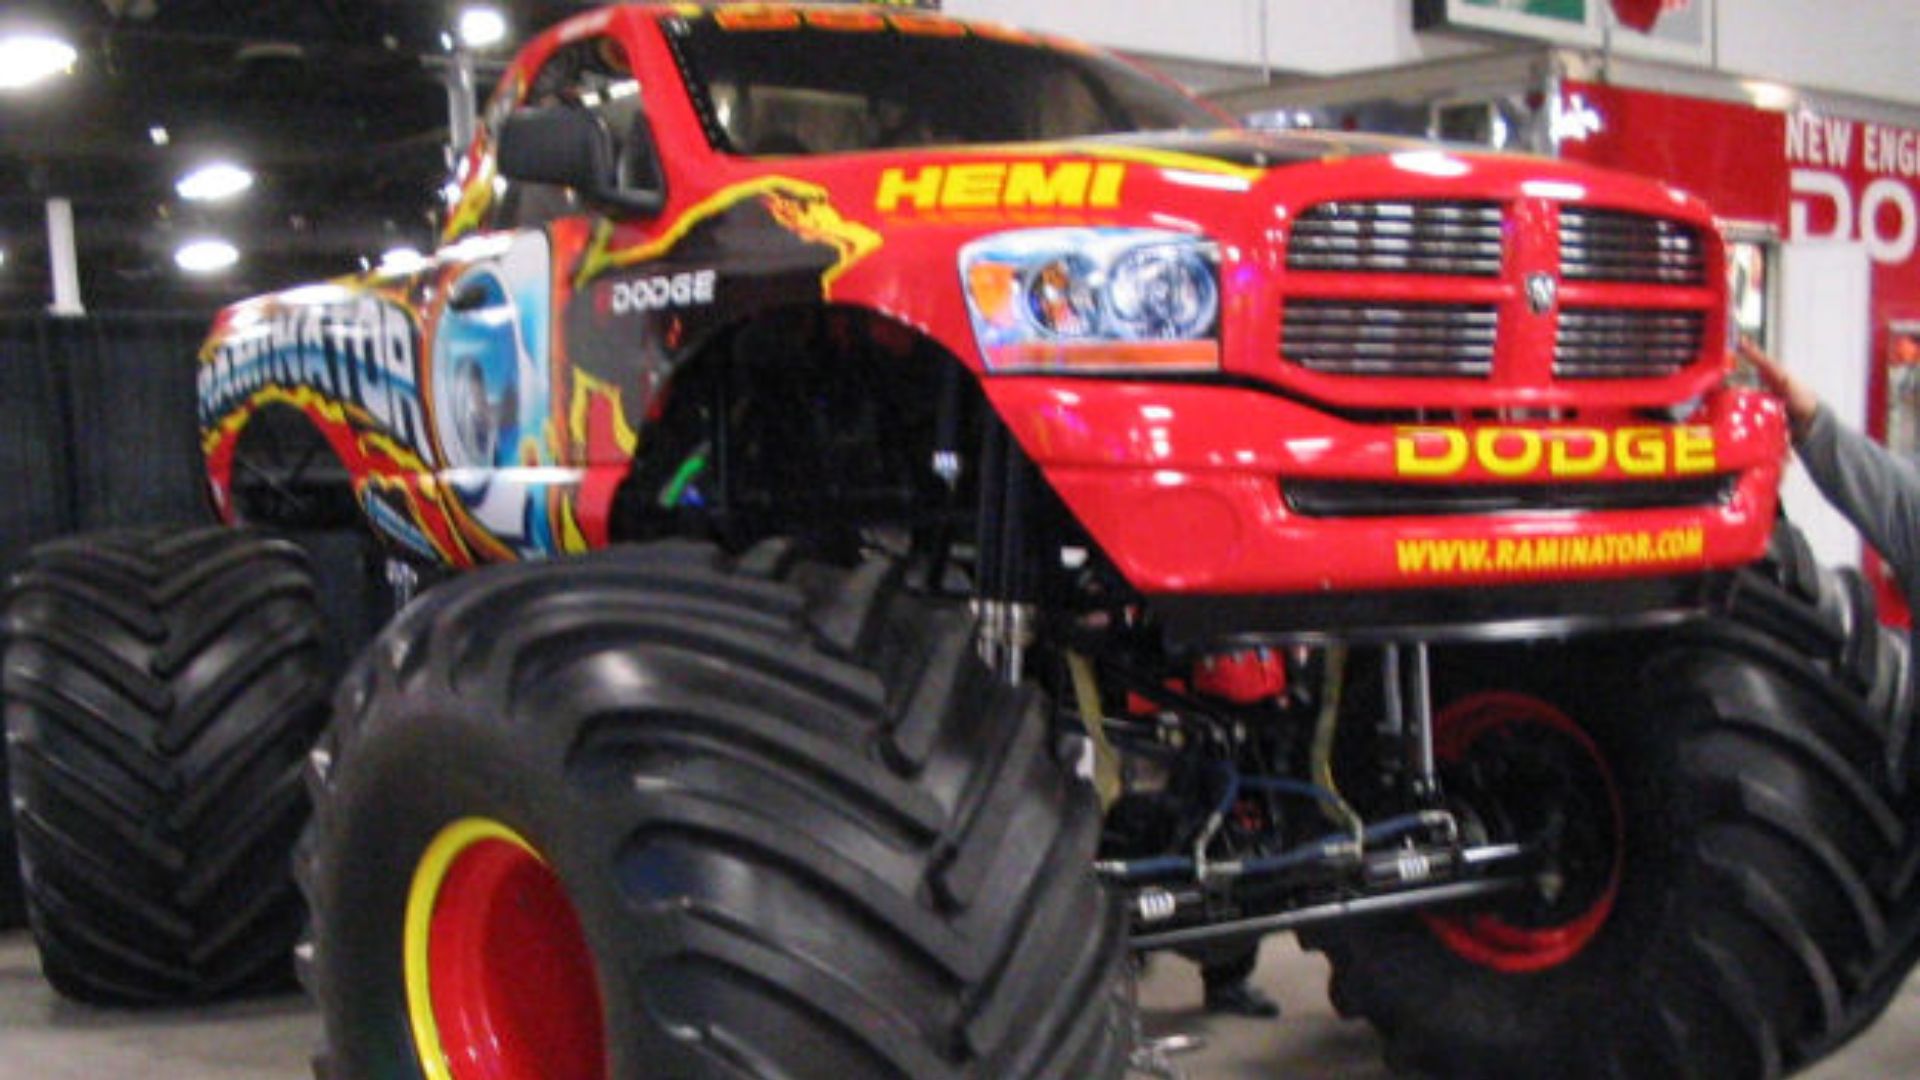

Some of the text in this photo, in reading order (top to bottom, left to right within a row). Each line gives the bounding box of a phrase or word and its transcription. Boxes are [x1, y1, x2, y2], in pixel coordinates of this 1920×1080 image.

[1785, 108, 1920, 176] NEW ENG
[876, 161, 1124, 211] HEMI
[612, 269, 716, 314] DODGE
[1396, 426, 1716, 475] DODGE
[1396, 528, 1703, 573] WWW.RAMINATOR.COM
